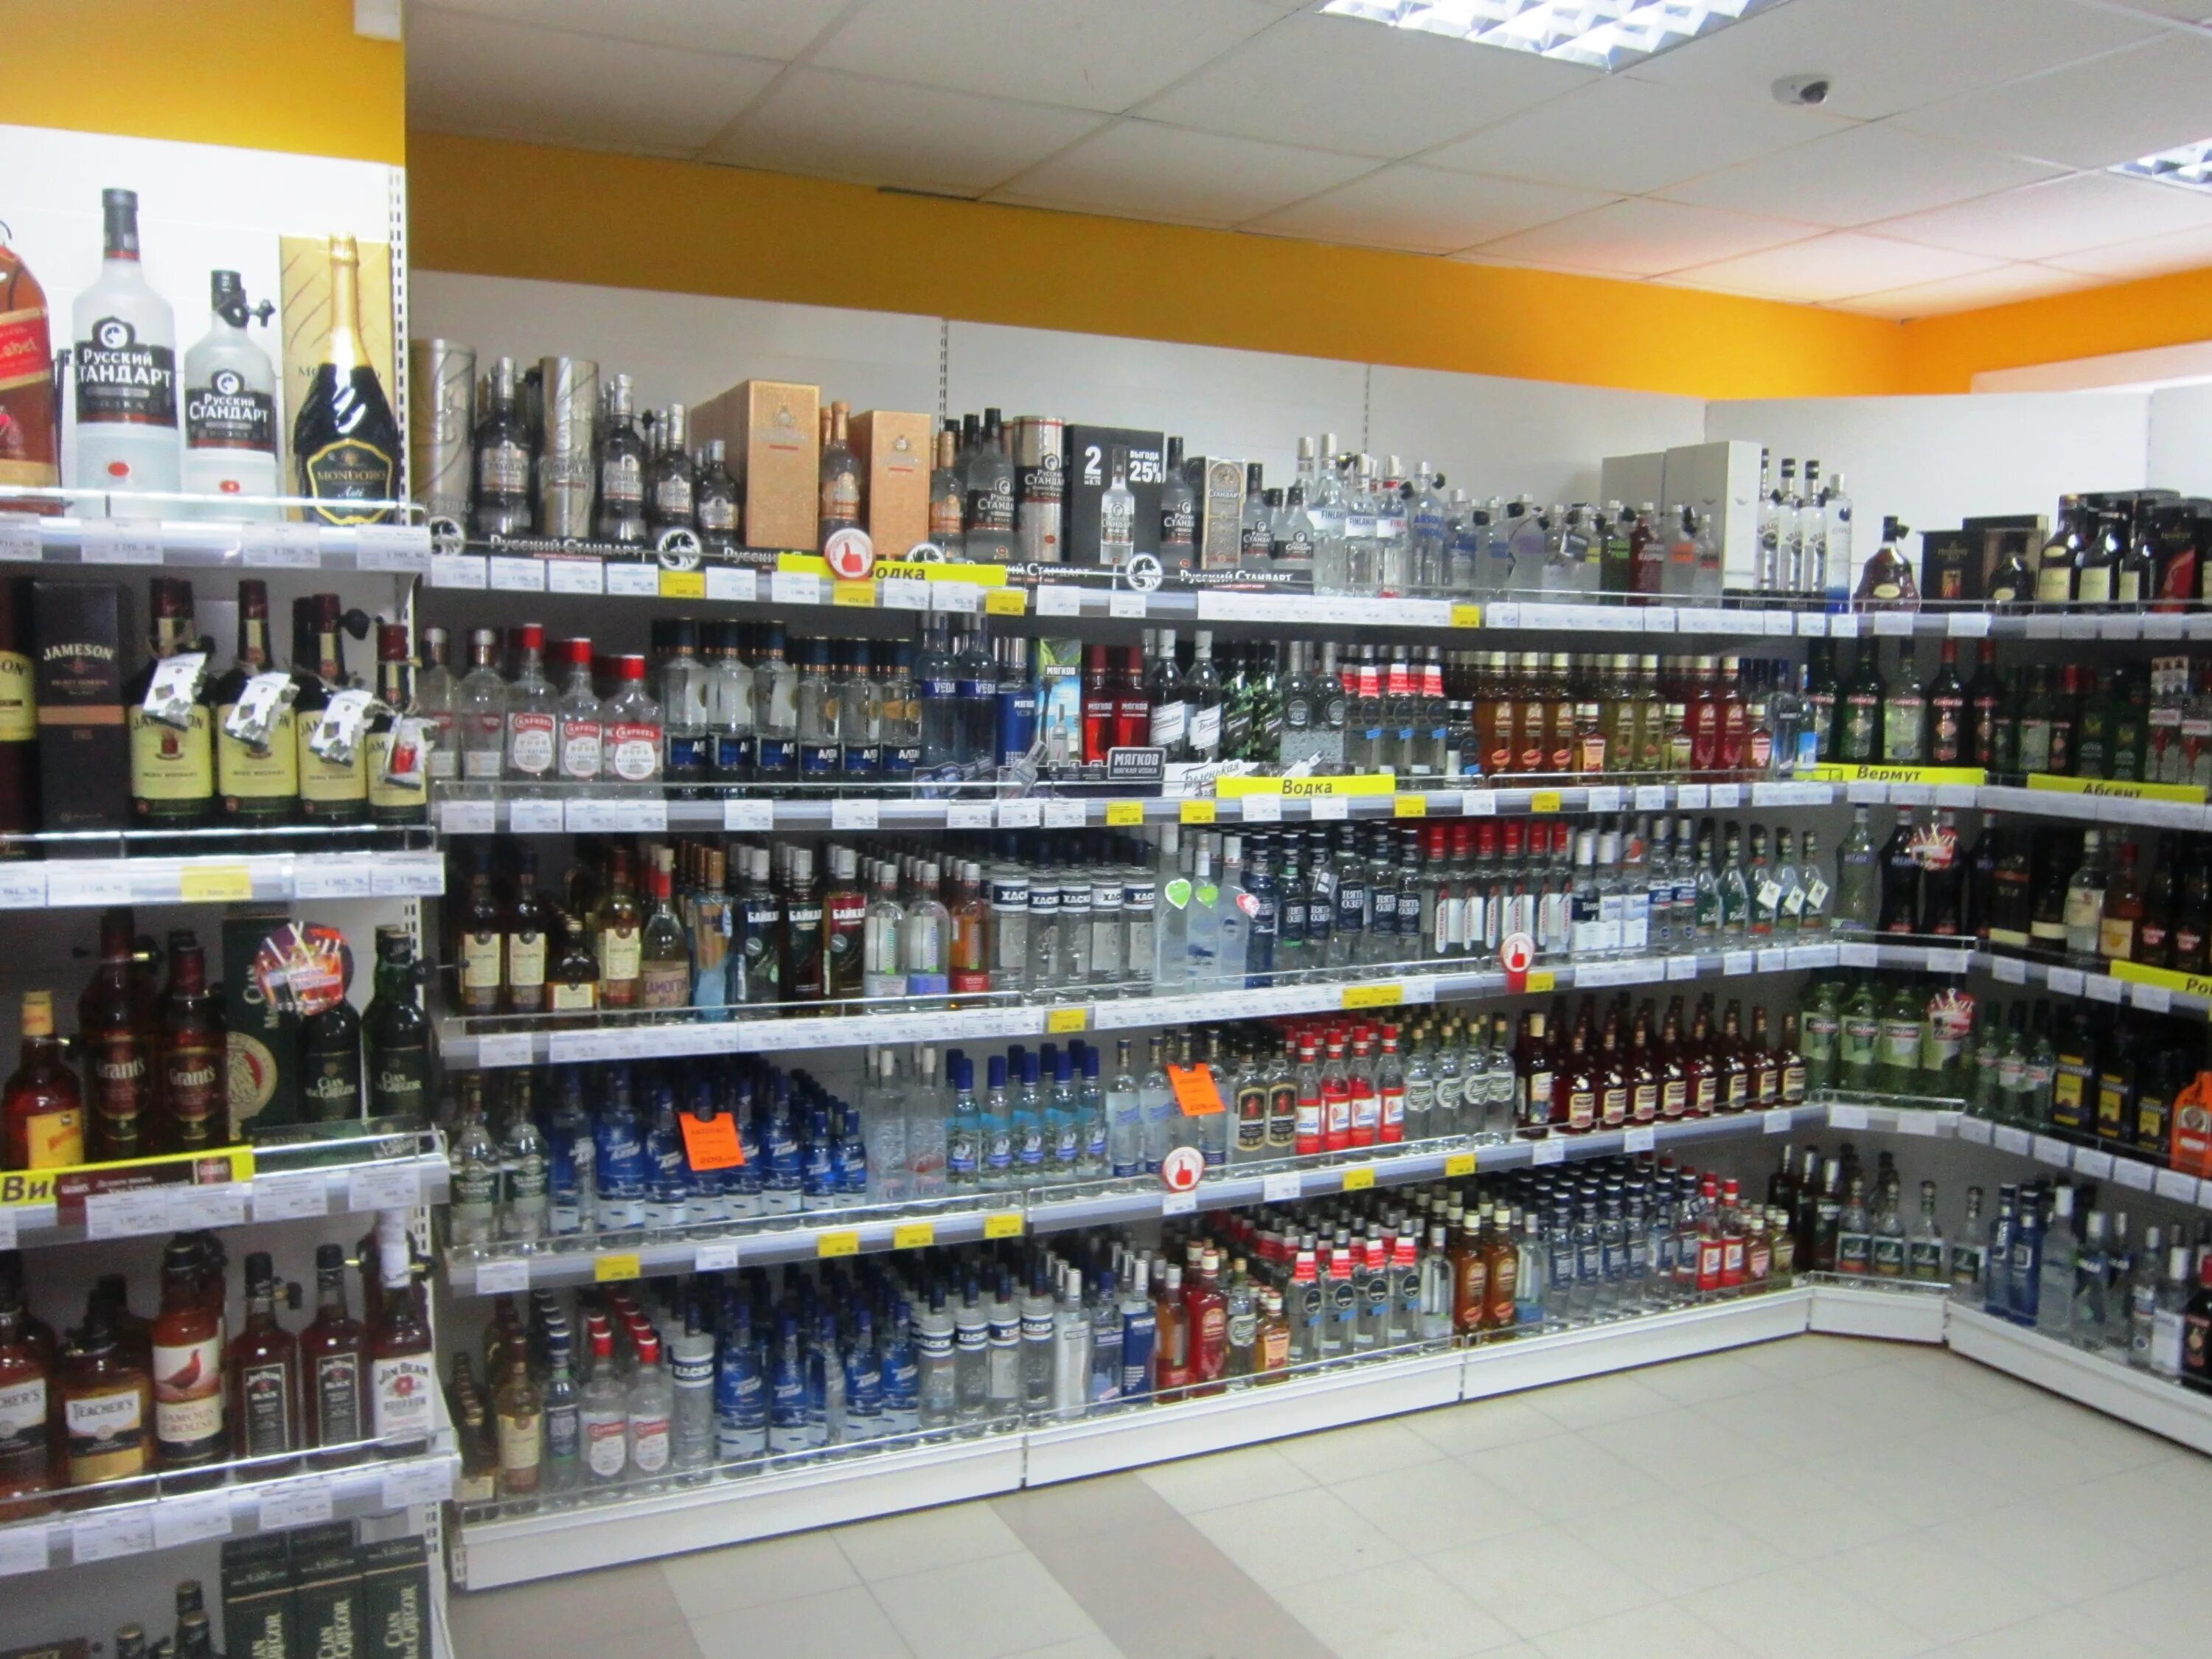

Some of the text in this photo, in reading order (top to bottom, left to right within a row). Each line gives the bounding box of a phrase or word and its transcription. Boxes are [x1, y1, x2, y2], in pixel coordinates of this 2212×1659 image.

[78, 364, 172, 387] ТАНДАРТ
[1085, 445, 1102, 476] 2
[1130, 449, 1160, 461] ВЫГОДА
[1129, 461, 1163, 484] 25%
[42, 642, 115, 661] JAMESON
[1046, 667, 1077, 676] МЯГКОВ
[1114, 753, 1159, 767] МЯГКОВ
[1857, 766, 1921, 782] Вермут
[1281, 779, 1333, 796] Водка
[2, 1175, 57, 1203] Ви
